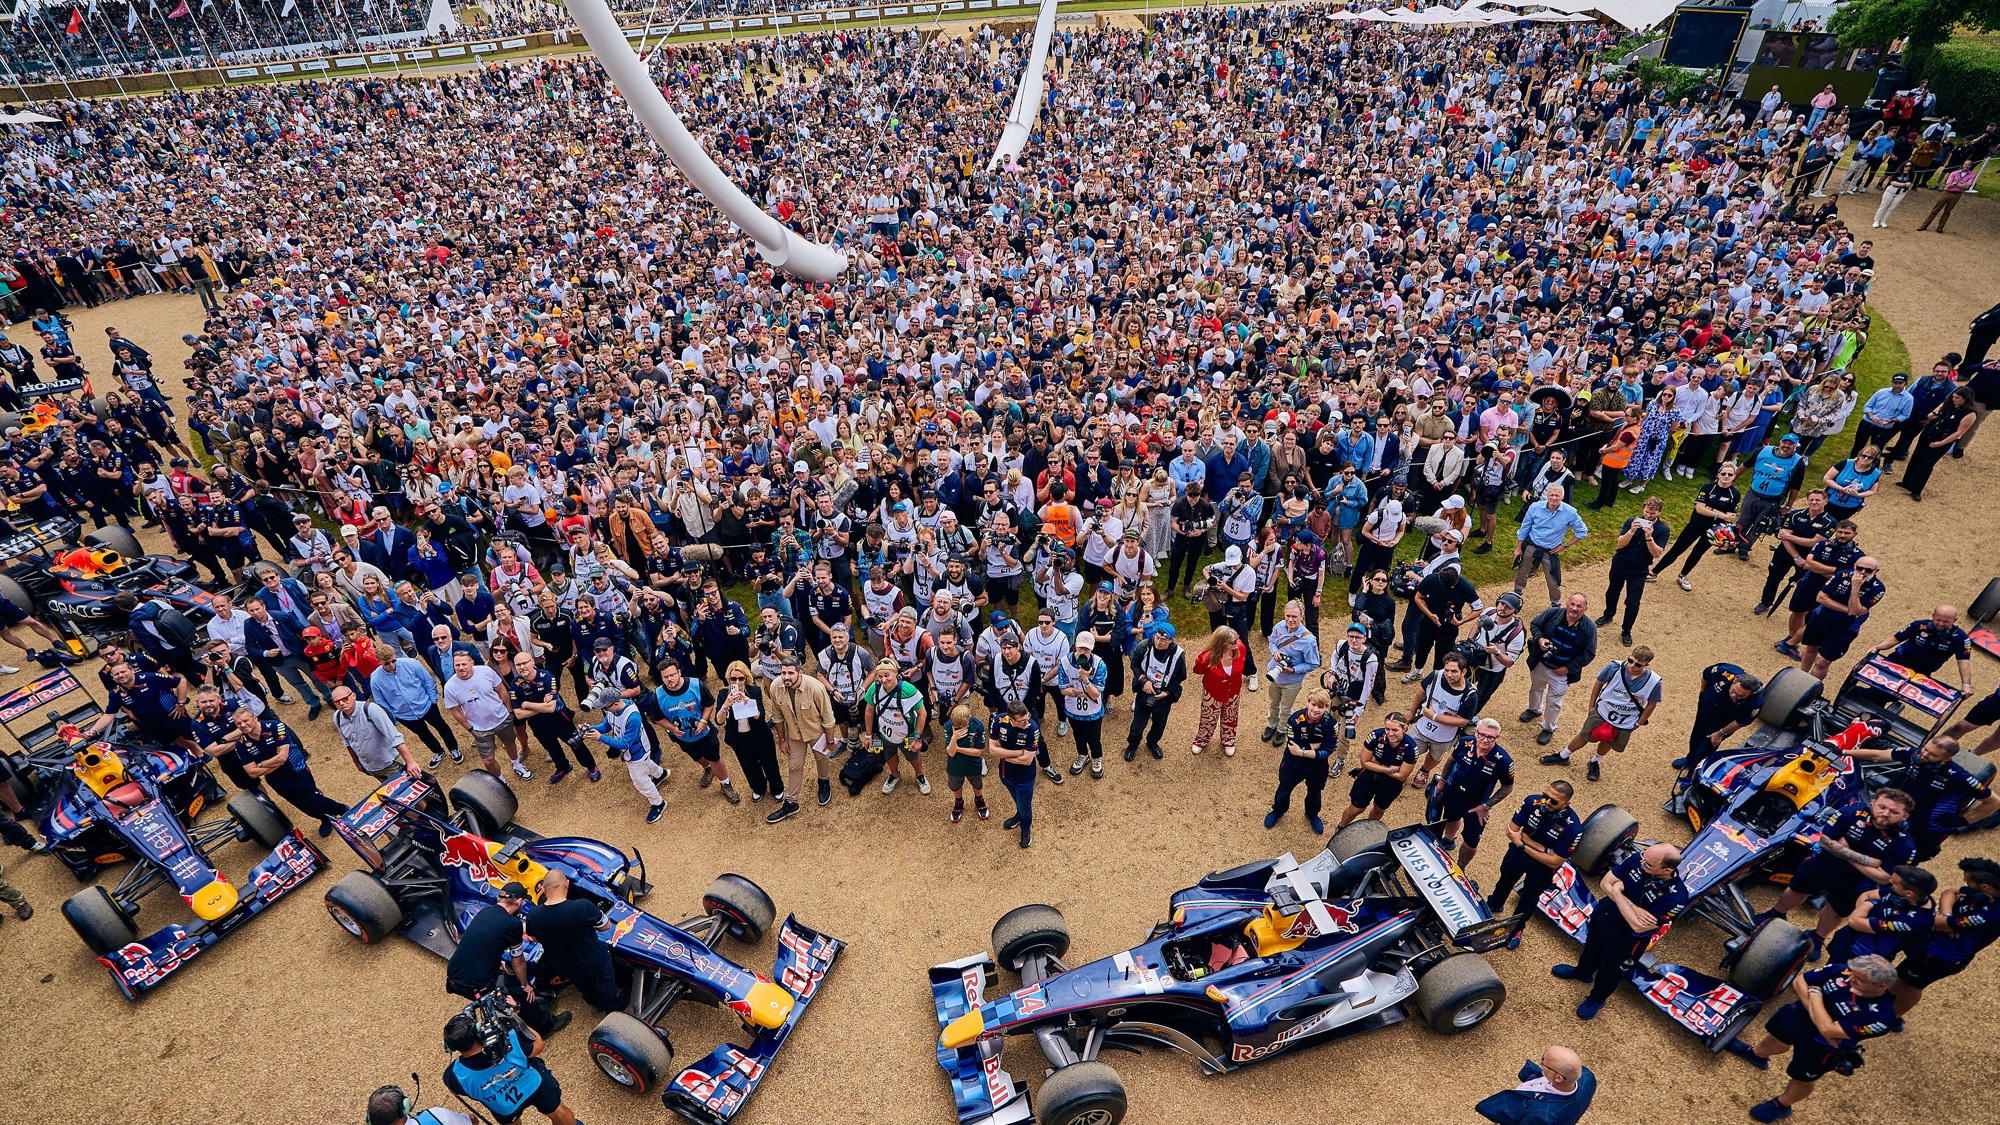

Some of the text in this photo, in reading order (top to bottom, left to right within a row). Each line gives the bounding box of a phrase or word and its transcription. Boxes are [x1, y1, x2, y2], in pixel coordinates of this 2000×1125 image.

[21, 377, 81, 393] HONDA
[1758, 481, 1769, 492] 41
[1231, 523, 1239, 534] 83
[826, 547, 832, 557] 2
[48, 600, 112, 618] ORACLE
[1858, 663, 1951, 714] Red Bull
[0, 677, 78, 720] Red Bull
[1077, 697, 1087, 711] 86
[1608, 711, 1631, 725] 67
[882, 726, 892, 737] 40
[1426, 722, 1438, 734] 97
[360, 805, 399, 838] Red
[392, 779, 430, 807] Bull
[1704, 845, 1729, 862] SINGHA
[1398, 840, 1430, 872] GIVES
[1423, 872, 1448, 897] YOU
[669, 946, 682, 956] 6
[1014, 983, 1047, 1016] 14
[593, 1043, 624, 1061] ZERO
[485, 1094, 497, 1102] TV
[497, 1071, 525, 1095] TRACK
[983, 1053, 1010, 1108] Bull
[504, 1086, 524, 1106] 12
